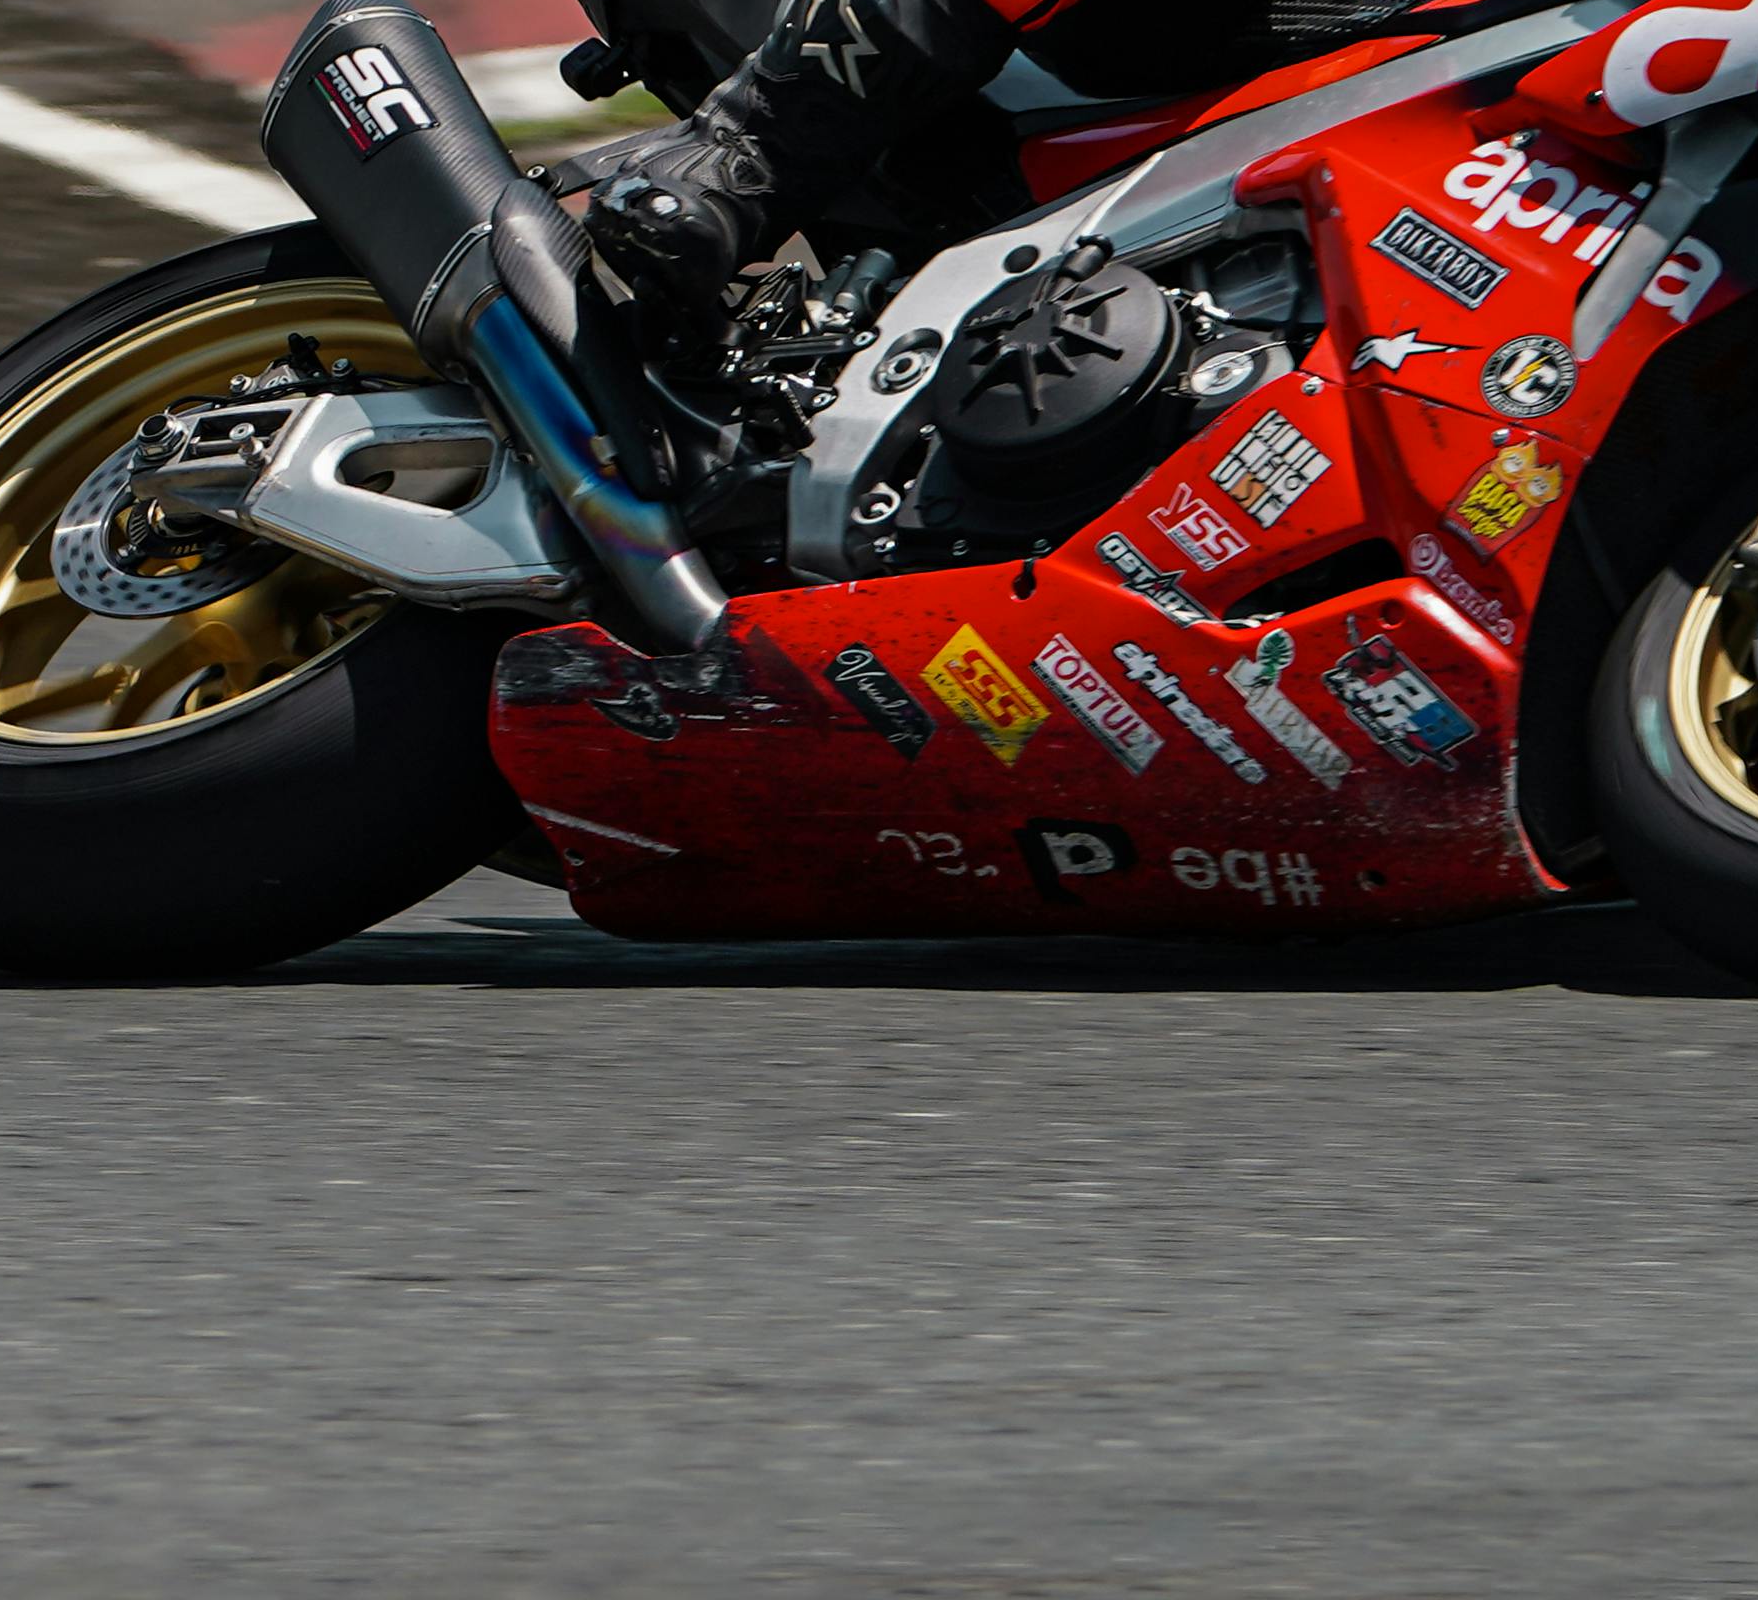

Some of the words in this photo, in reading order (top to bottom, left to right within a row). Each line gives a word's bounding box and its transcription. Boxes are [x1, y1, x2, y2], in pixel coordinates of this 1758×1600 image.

[323, 64, 385, 142] PROJECT
[335, 46, 434, 137] SC
[1385, 220, 1494, 297] BIKERBOX
[1443, 140, 1723, 324] apria
[1151, 487, 1246, 563] YSS
[1100, 536, 1204, 623] QSTARZ
[943, 647, 1035, 729] SSS
[1039, 637, 1140, 748] TOPTUL
